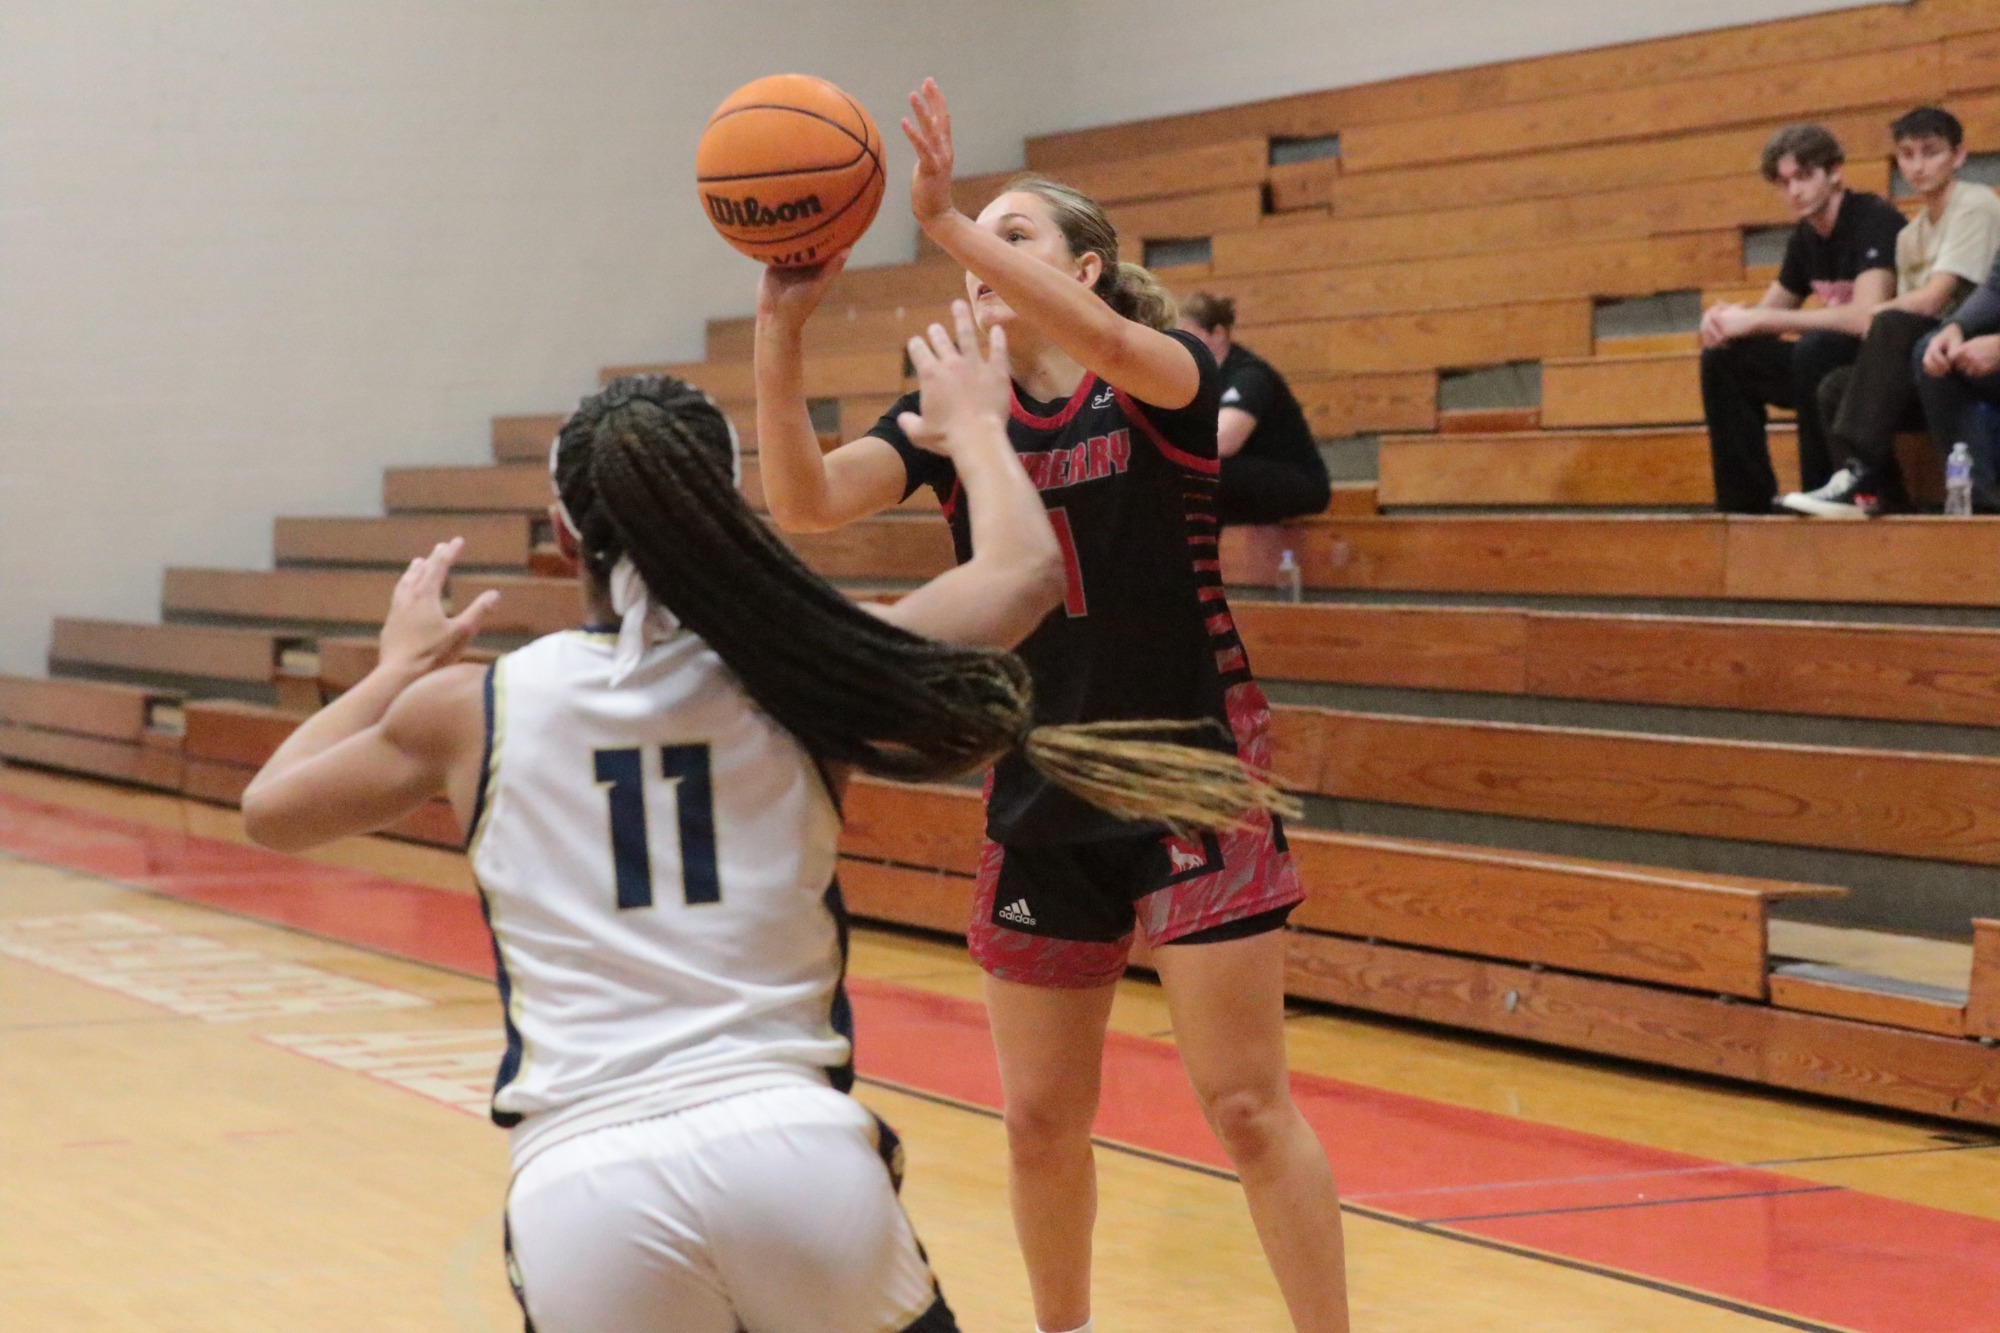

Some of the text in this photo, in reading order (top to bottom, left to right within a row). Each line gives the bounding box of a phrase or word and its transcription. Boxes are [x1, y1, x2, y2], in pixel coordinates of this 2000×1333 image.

[705, 193, 823, 227] Wilson
[1016, 427, 1131, 491] BERRY
[592, 740, 722, 911] 11
[998, 909, 1037, 926] adidas
